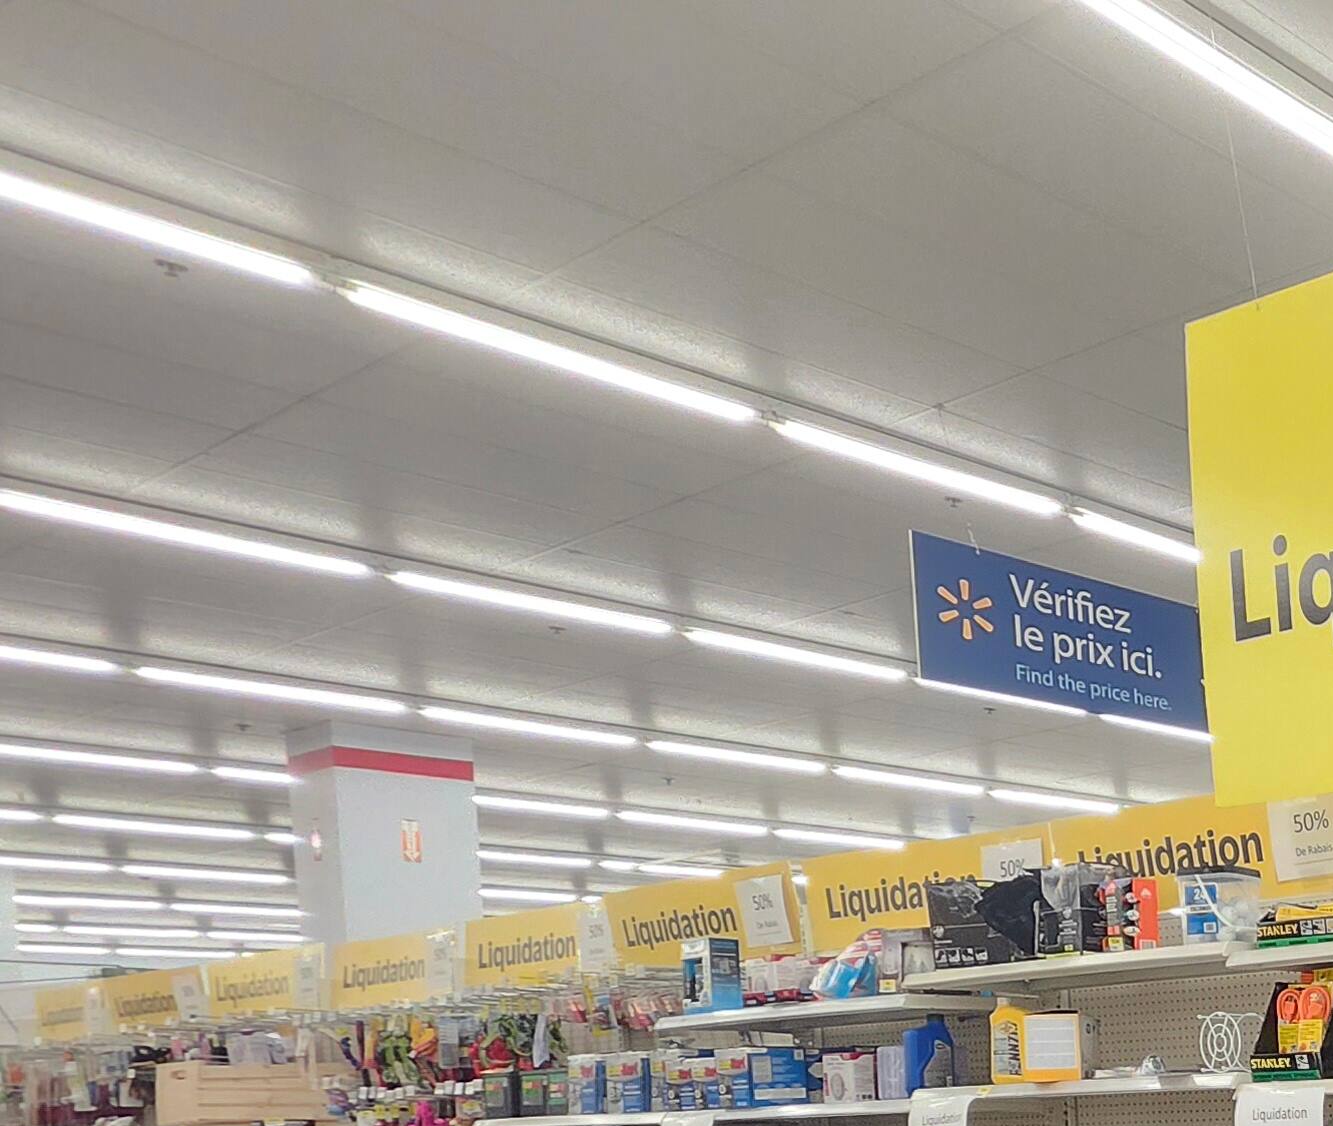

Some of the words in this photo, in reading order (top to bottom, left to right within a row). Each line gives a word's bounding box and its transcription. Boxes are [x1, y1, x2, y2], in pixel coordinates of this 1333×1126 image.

[1009, 574, 1132, 634] Vérifiez
[1013, 615, 1044, 651] le
[1053, 630, 1115, 669] prix
[1121, 641, 1163, 679] ici.
[1016, 664, 1054, 688] Find
[1058, 673, 1086, 694] the
[1090, 681, 1131, 704] price
[1134, 688, 1172, 711] here.
[1293, 809, 1330, 833] 50%
[1295, 845, 1307, 857] De
[1308, 842, 1333, 855] Rabais
[999, 859, 1025, 878] 50%
[752, 893, 774, 912] 50%
[825, 870, 977, 922] Liquida
[622, 904, 738, 950] Liquidation
[1256, 923, 1298, 938] STANLEY
[477, 933, 577, 971] Liquidation
[215, 970, 290, 1008] Liquidation
[343, 956, 426, 991] Liquidation
[1250, 1057, 1292, 1069] STANLEY
[1252, 1107, 1308, 1123] Liquidation
